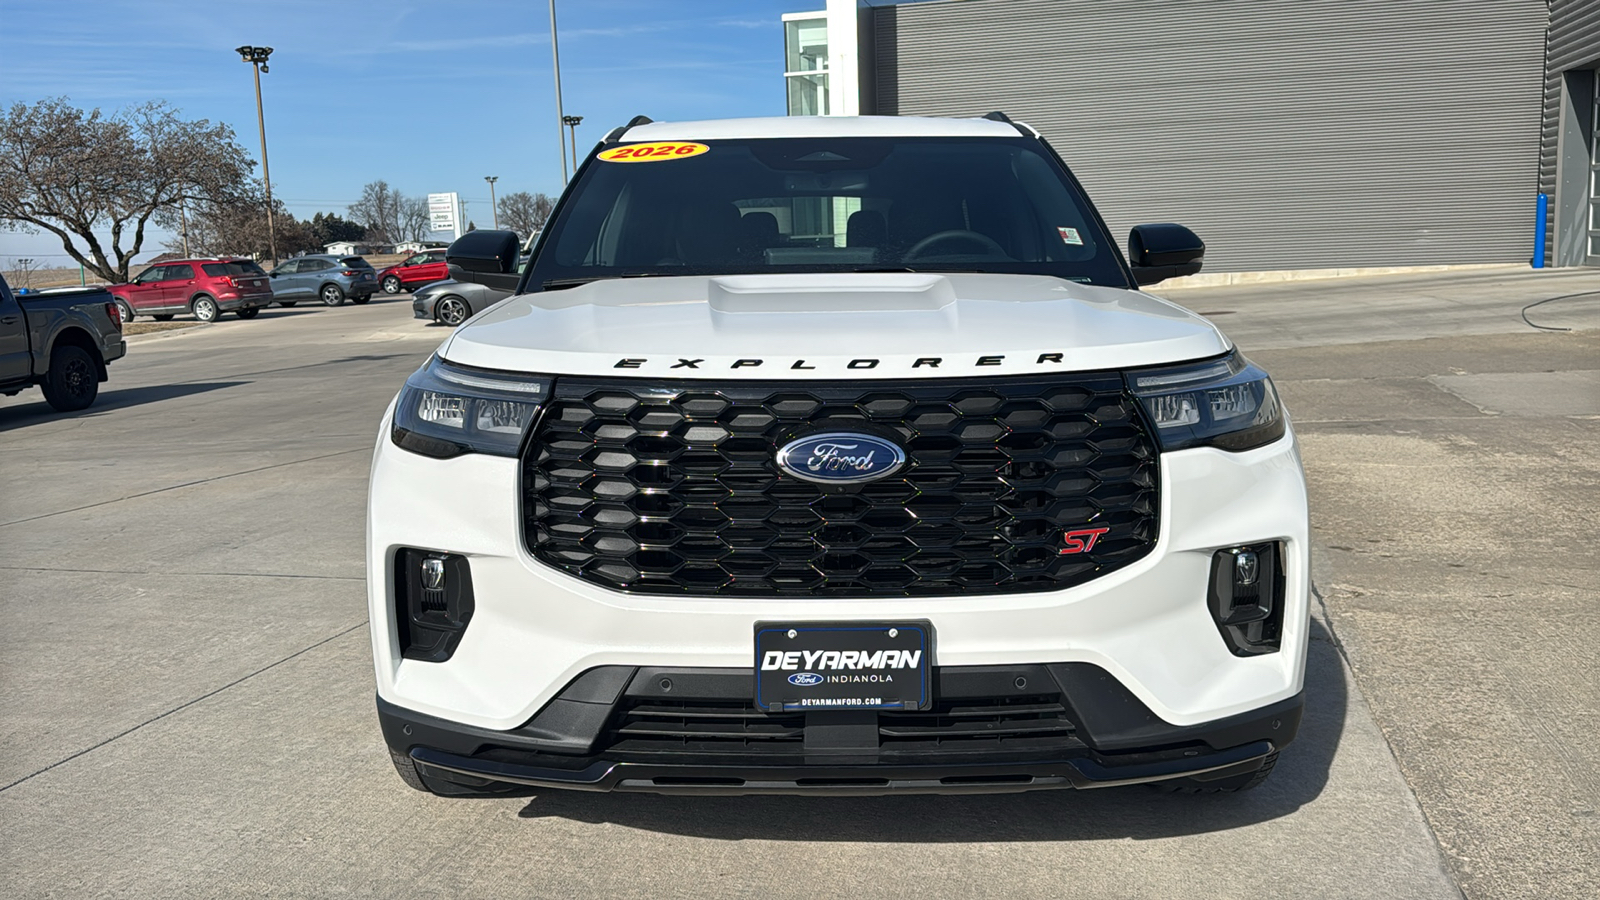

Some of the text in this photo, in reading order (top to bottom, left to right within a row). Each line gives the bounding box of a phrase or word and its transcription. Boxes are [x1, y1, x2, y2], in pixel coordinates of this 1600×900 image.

[608, 145, 698, 159] 2026
[613, 352, 1064, 369] EXPLORER
[807, 443, 875, 471] Ford
[1059, 527, 1110, 554] ST
[761, 650, 921, 670] DEYARMAN
[794, 674, 893, 684] Ford INDIANOLA
[802, 698, 881, 706] DEYARMANFORD.COM
